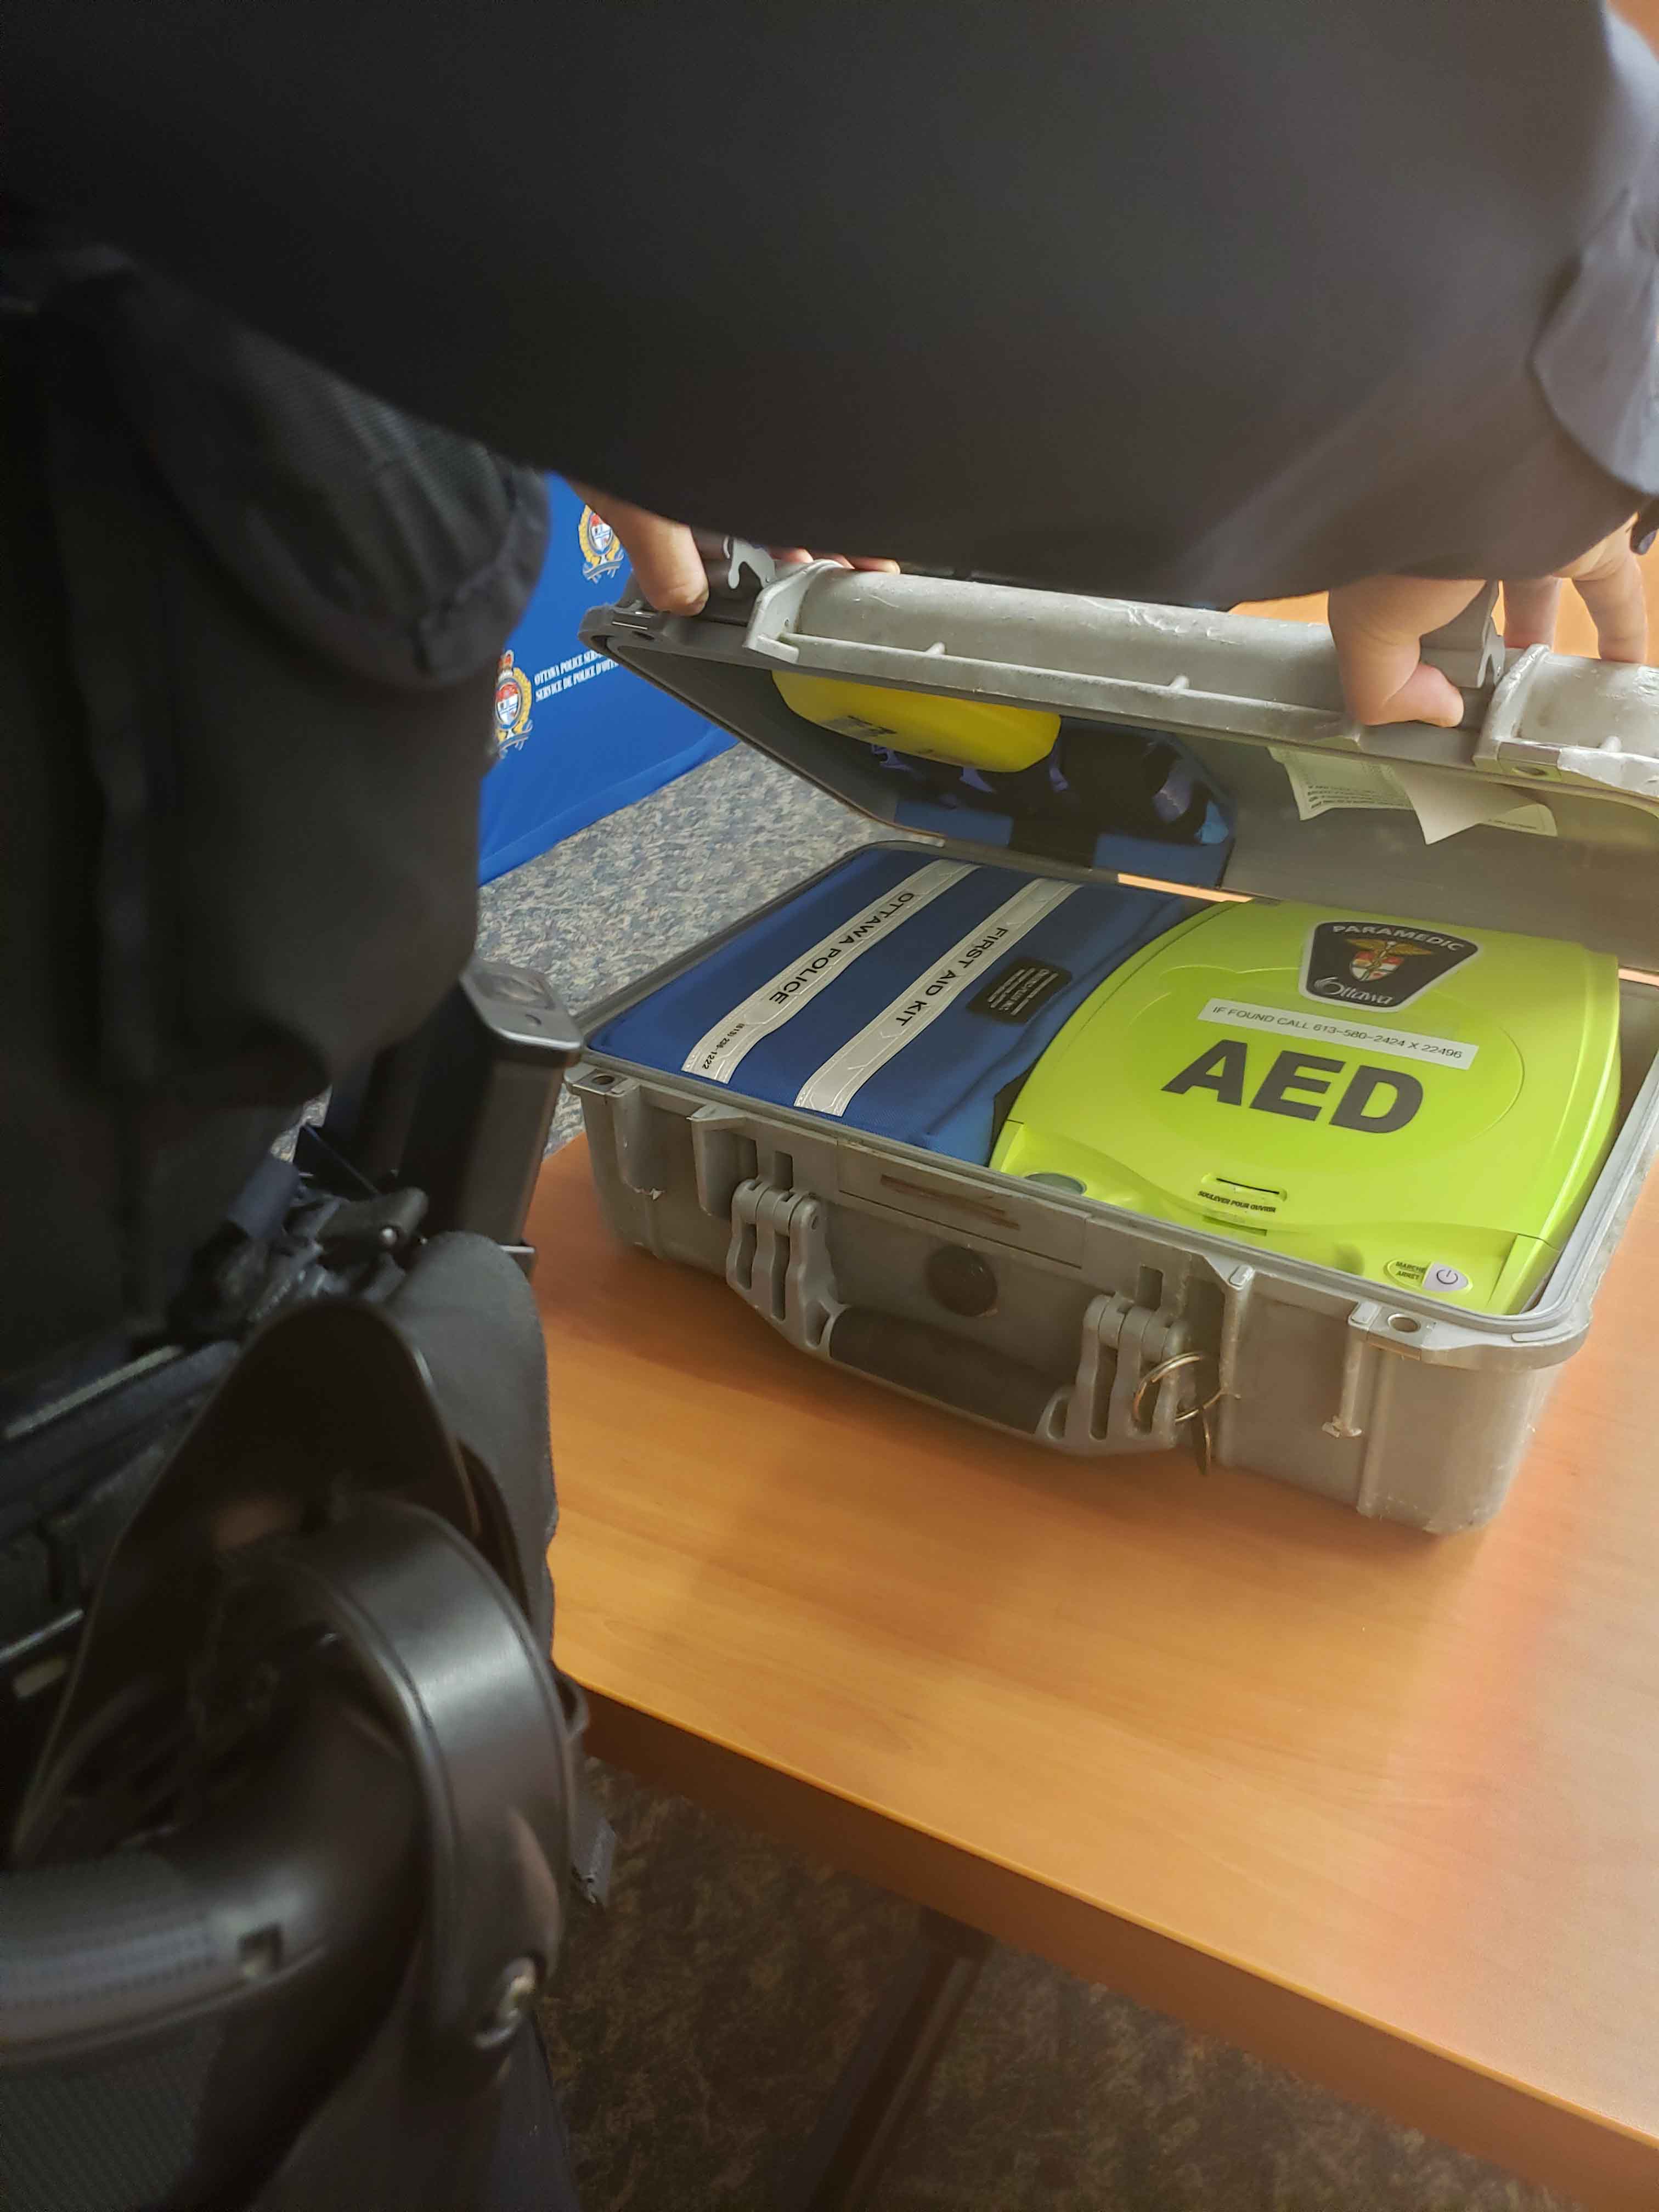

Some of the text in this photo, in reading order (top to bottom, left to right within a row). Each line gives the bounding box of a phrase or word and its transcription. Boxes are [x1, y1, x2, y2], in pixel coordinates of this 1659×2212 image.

[769, 893, 914, 1004] OTTAWA POLICE
[1333, 926, 1464, 951] PARAMEDIC
[896, 927, 1008, 1026] FIRST AID KIT
[1314, 977, 1393, 1005] Ottawa
[702, 1023, 745, 1069] (613) 236-1222
[1228, 1009, 1275, 1022] FOUND
[1277, 1017, 1308, 1029] CALL
[1313, 1024, 1405, 1047] 613-580-2424
[1421, 1044, 1463, 1059] 22496
[1161, 1039, 1424, 1134] AED
[1231, 1200, 1250, 1209] POUR
